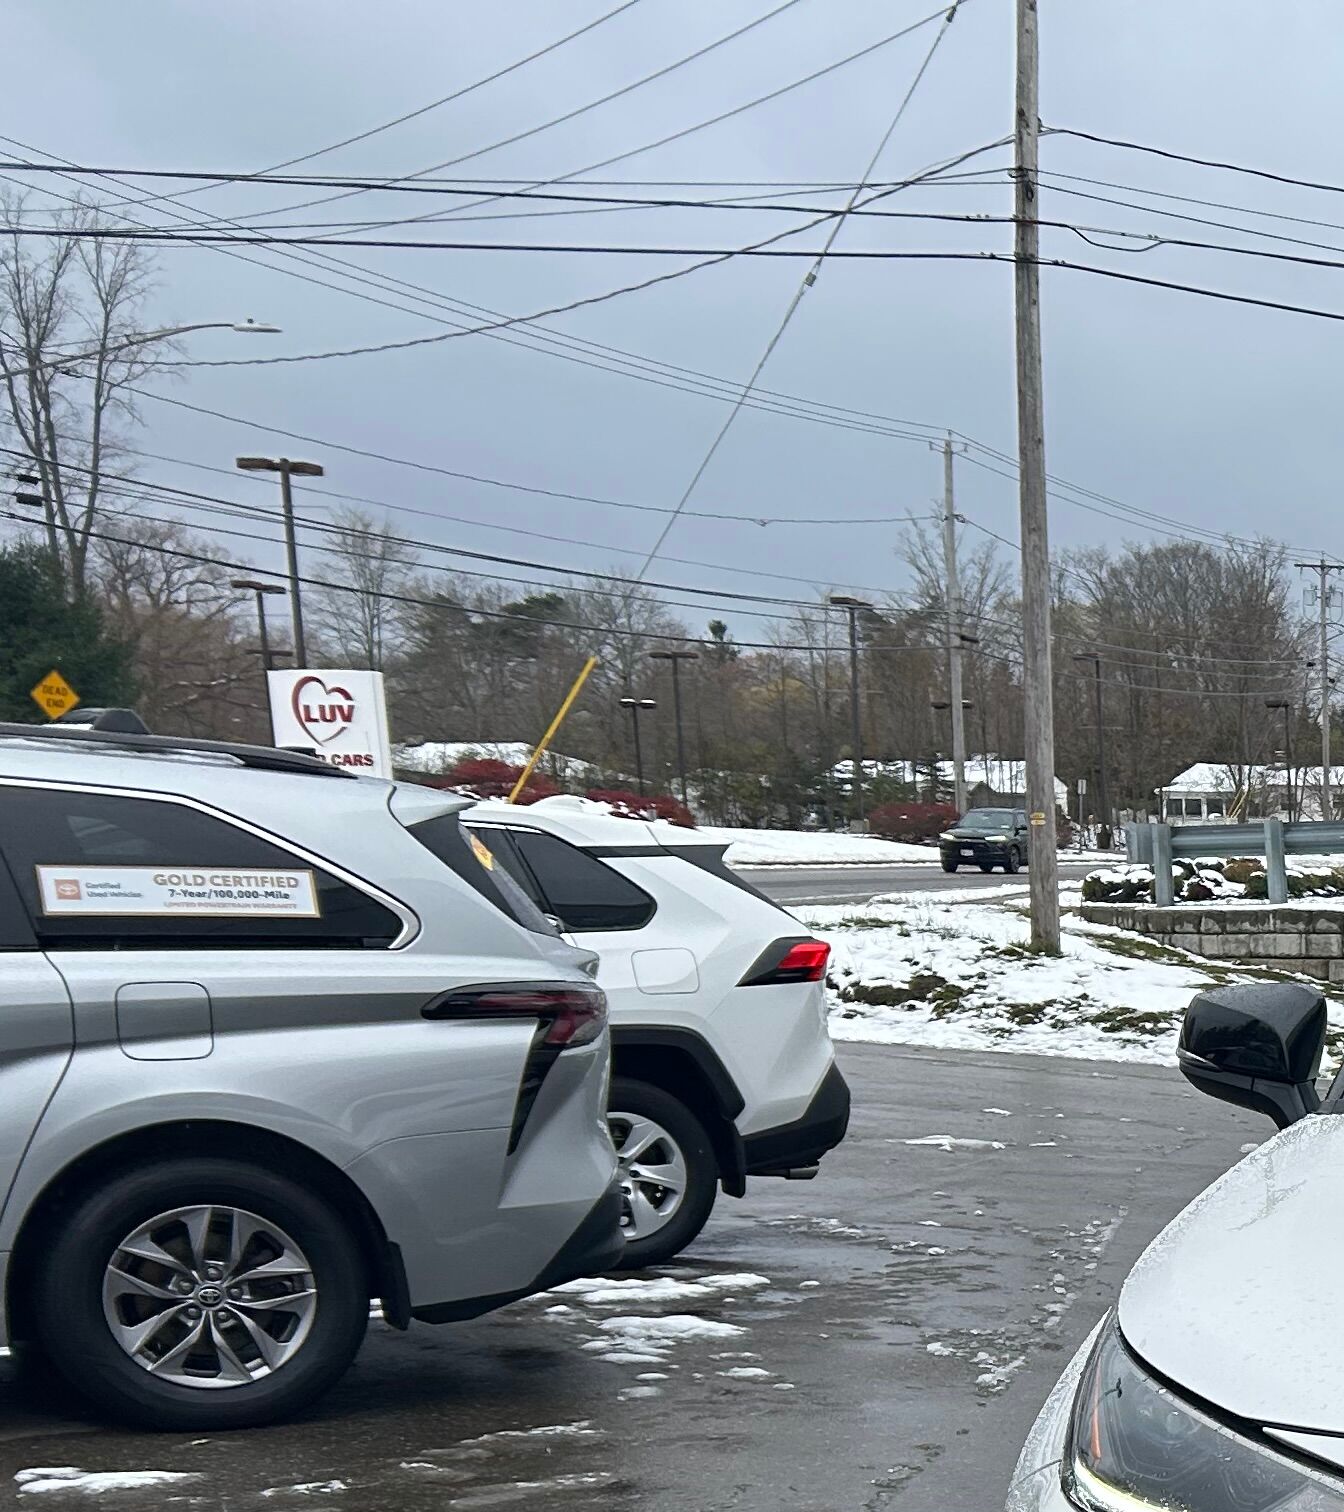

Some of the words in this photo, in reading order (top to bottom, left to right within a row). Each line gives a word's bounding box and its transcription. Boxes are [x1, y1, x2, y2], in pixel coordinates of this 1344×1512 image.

[42, 685, 68, 696] DEAD
[46, 698, 65, 708] END
[303, 705, 355, 722] LUV
[331, 754, 374, 766] CARS
[153, 873, 206, 887] GOLD
[209, 875, 300, 889] CERTIFIED
[168, 888, 290, 900] 7-Year/100,000-Mile
